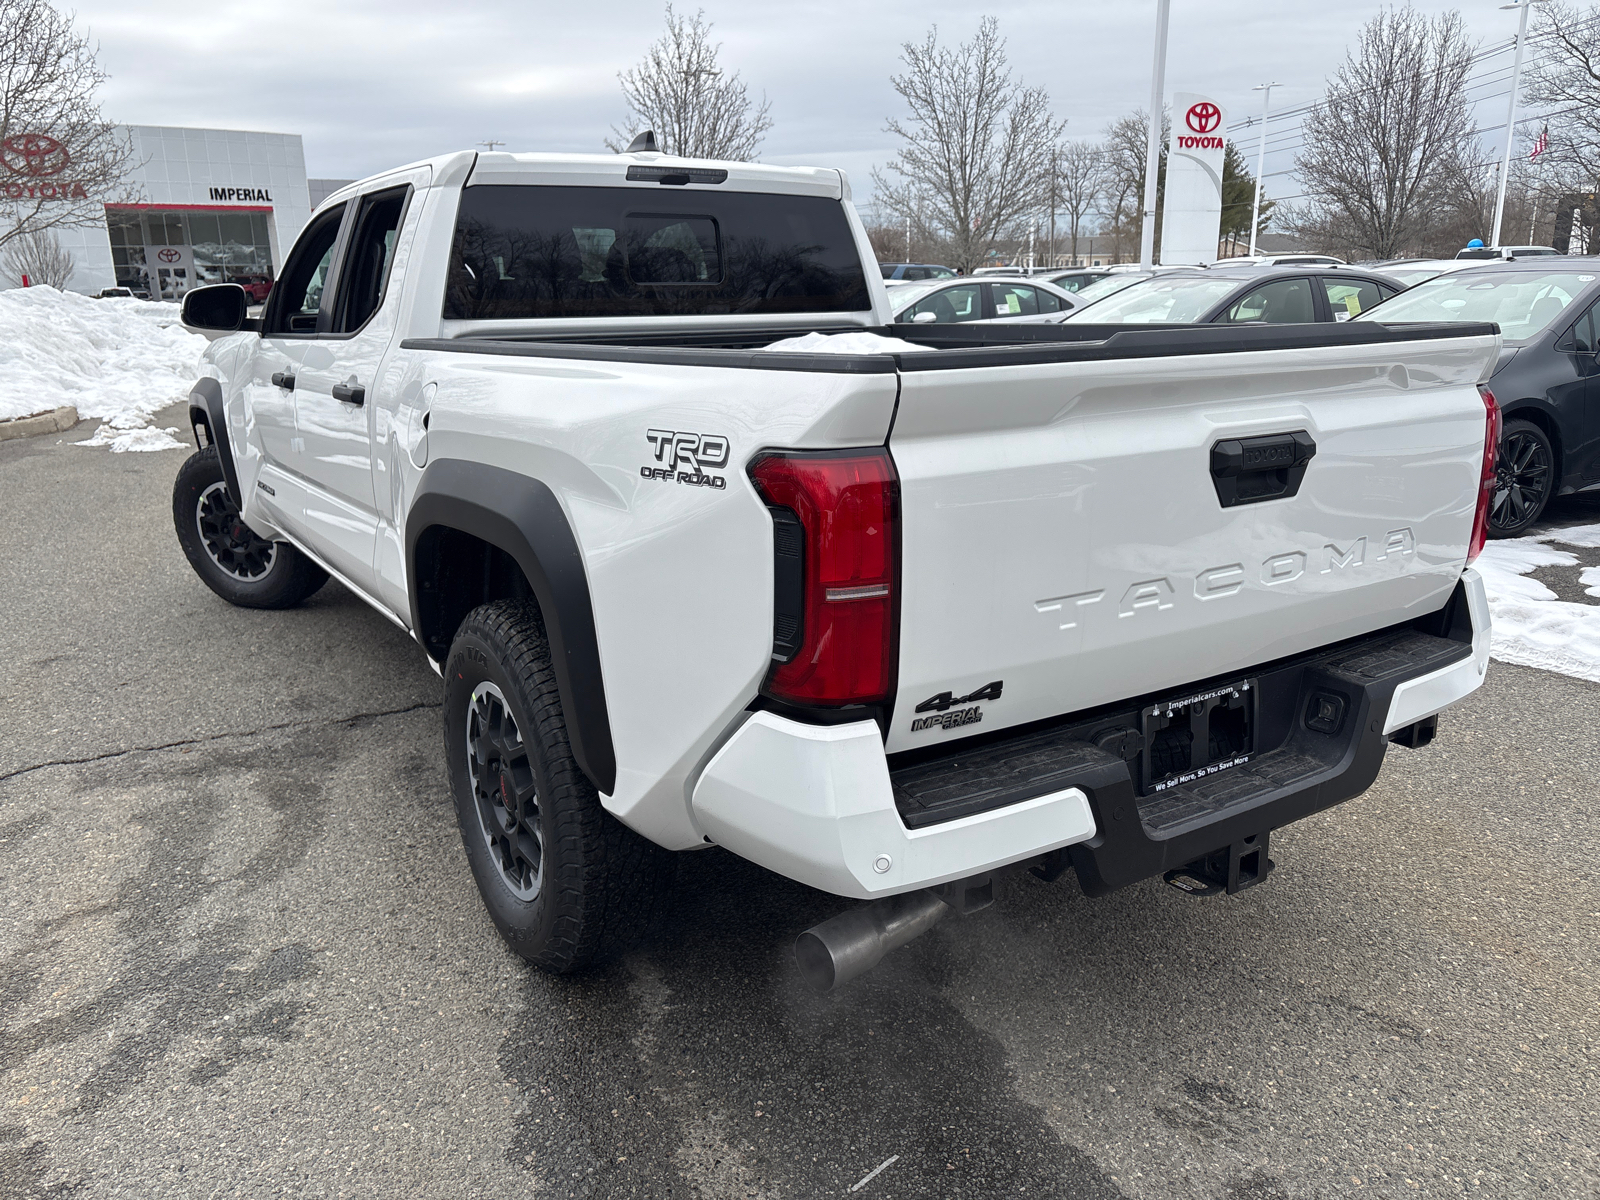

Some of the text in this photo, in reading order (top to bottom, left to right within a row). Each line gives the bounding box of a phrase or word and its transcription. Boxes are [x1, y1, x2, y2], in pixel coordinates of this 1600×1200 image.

[1177, 136, 1224, 149] TOYOTA
[209, 187, 272, 202] IMPERIAL
[646, 428, 731, 473] TRD
[1245, 446, 1293, 464] TOYOTA
[640, 466, 727, 490] OFF ROAD
[1034, 526, 1416, 630] TACOMA
[1168, 686, 1234, 709] Imperialcars.com
[911, 706, 983, 731] IMPERIAL
[1155, 783, 1166, 791] We
[1166, 779, 1178, 789] Sell
[1197, 770, 1206, 778] So
[1206, 766, 1219, 774] You
[1219, 761, 1233, 770] Save
[1234, 756, 1249, 765] More
